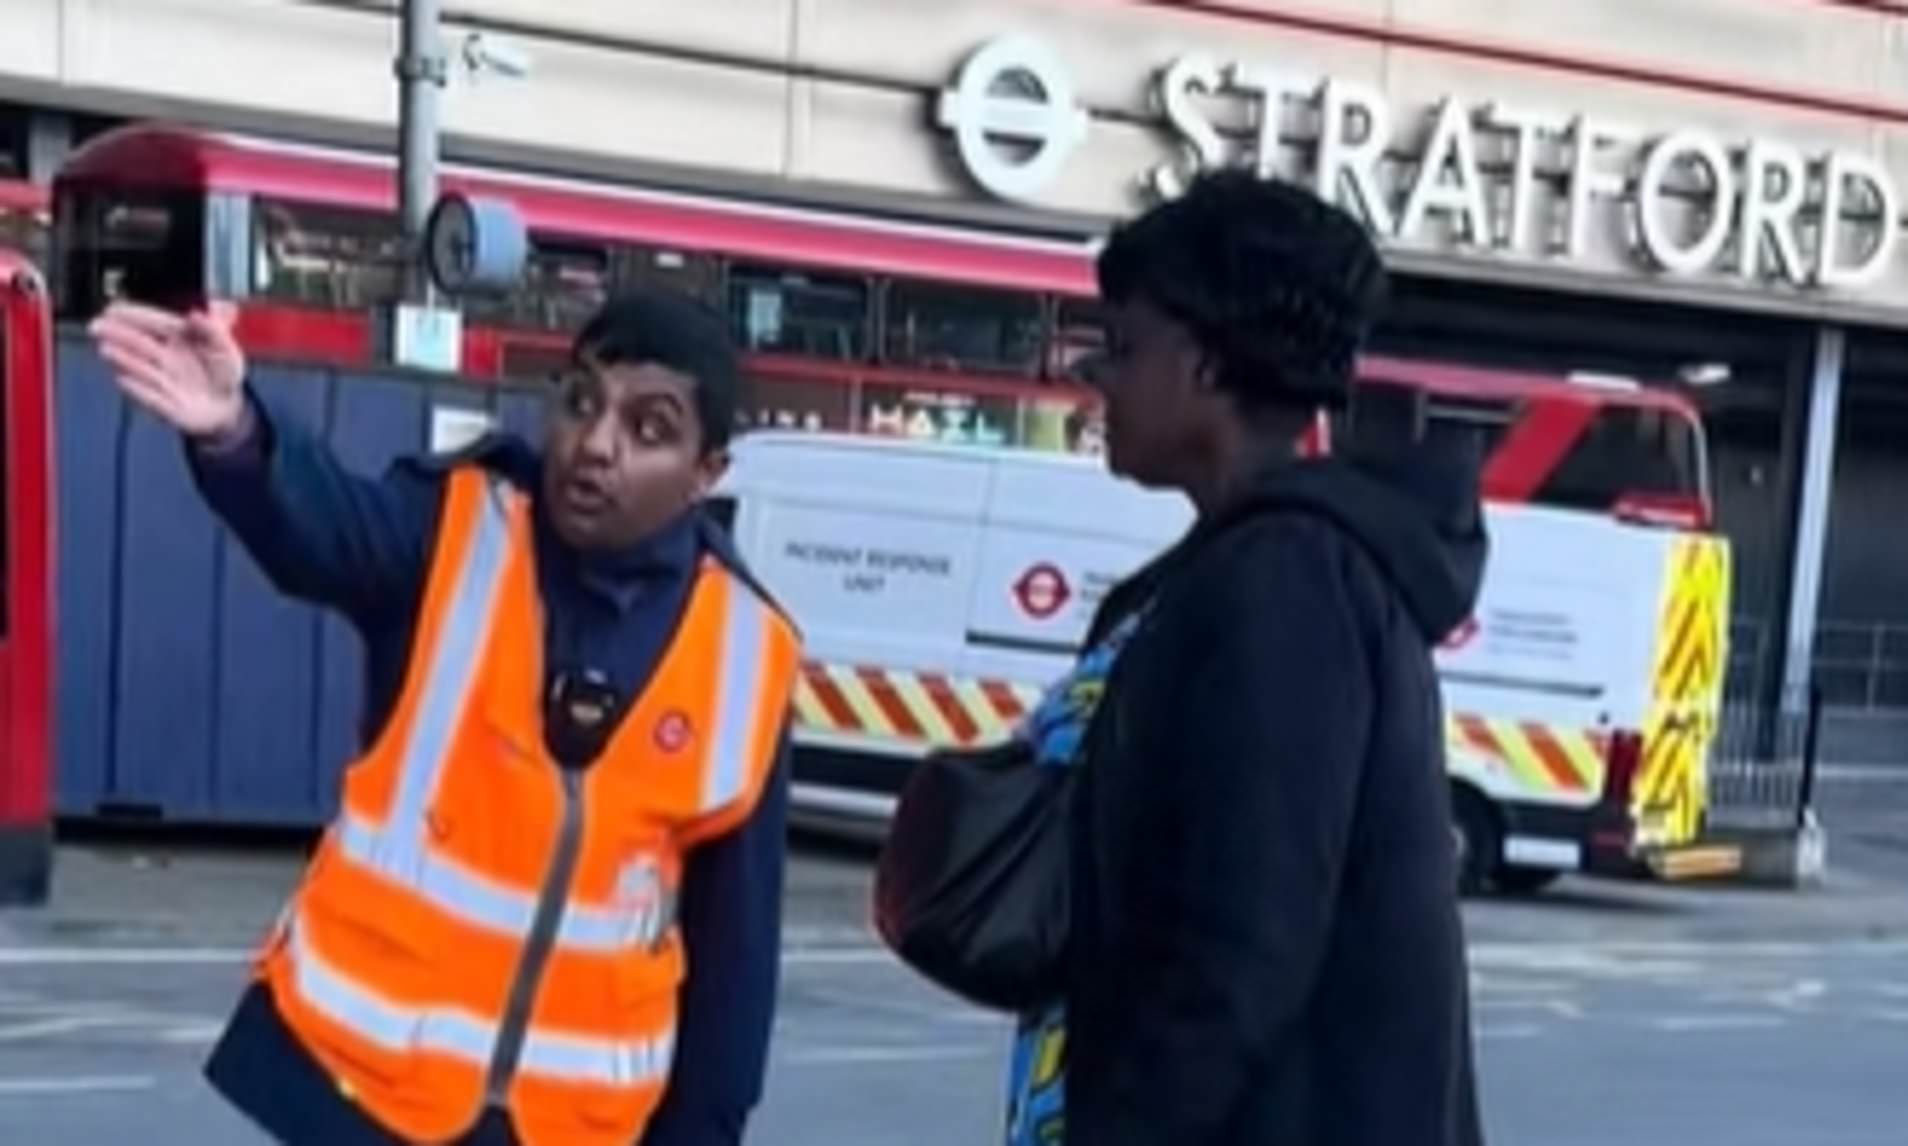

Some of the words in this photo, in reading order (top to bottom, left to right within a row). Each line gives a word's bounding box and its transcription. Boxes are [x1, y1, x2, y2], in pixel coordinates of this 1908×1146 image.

[1153, 50, 1900, 285] STRATFORD
[785, 541, 862, 565] INCIDENT
[866, 549, 949, 576] RESPONSE
[843, 574, 886, 593] UNIT
